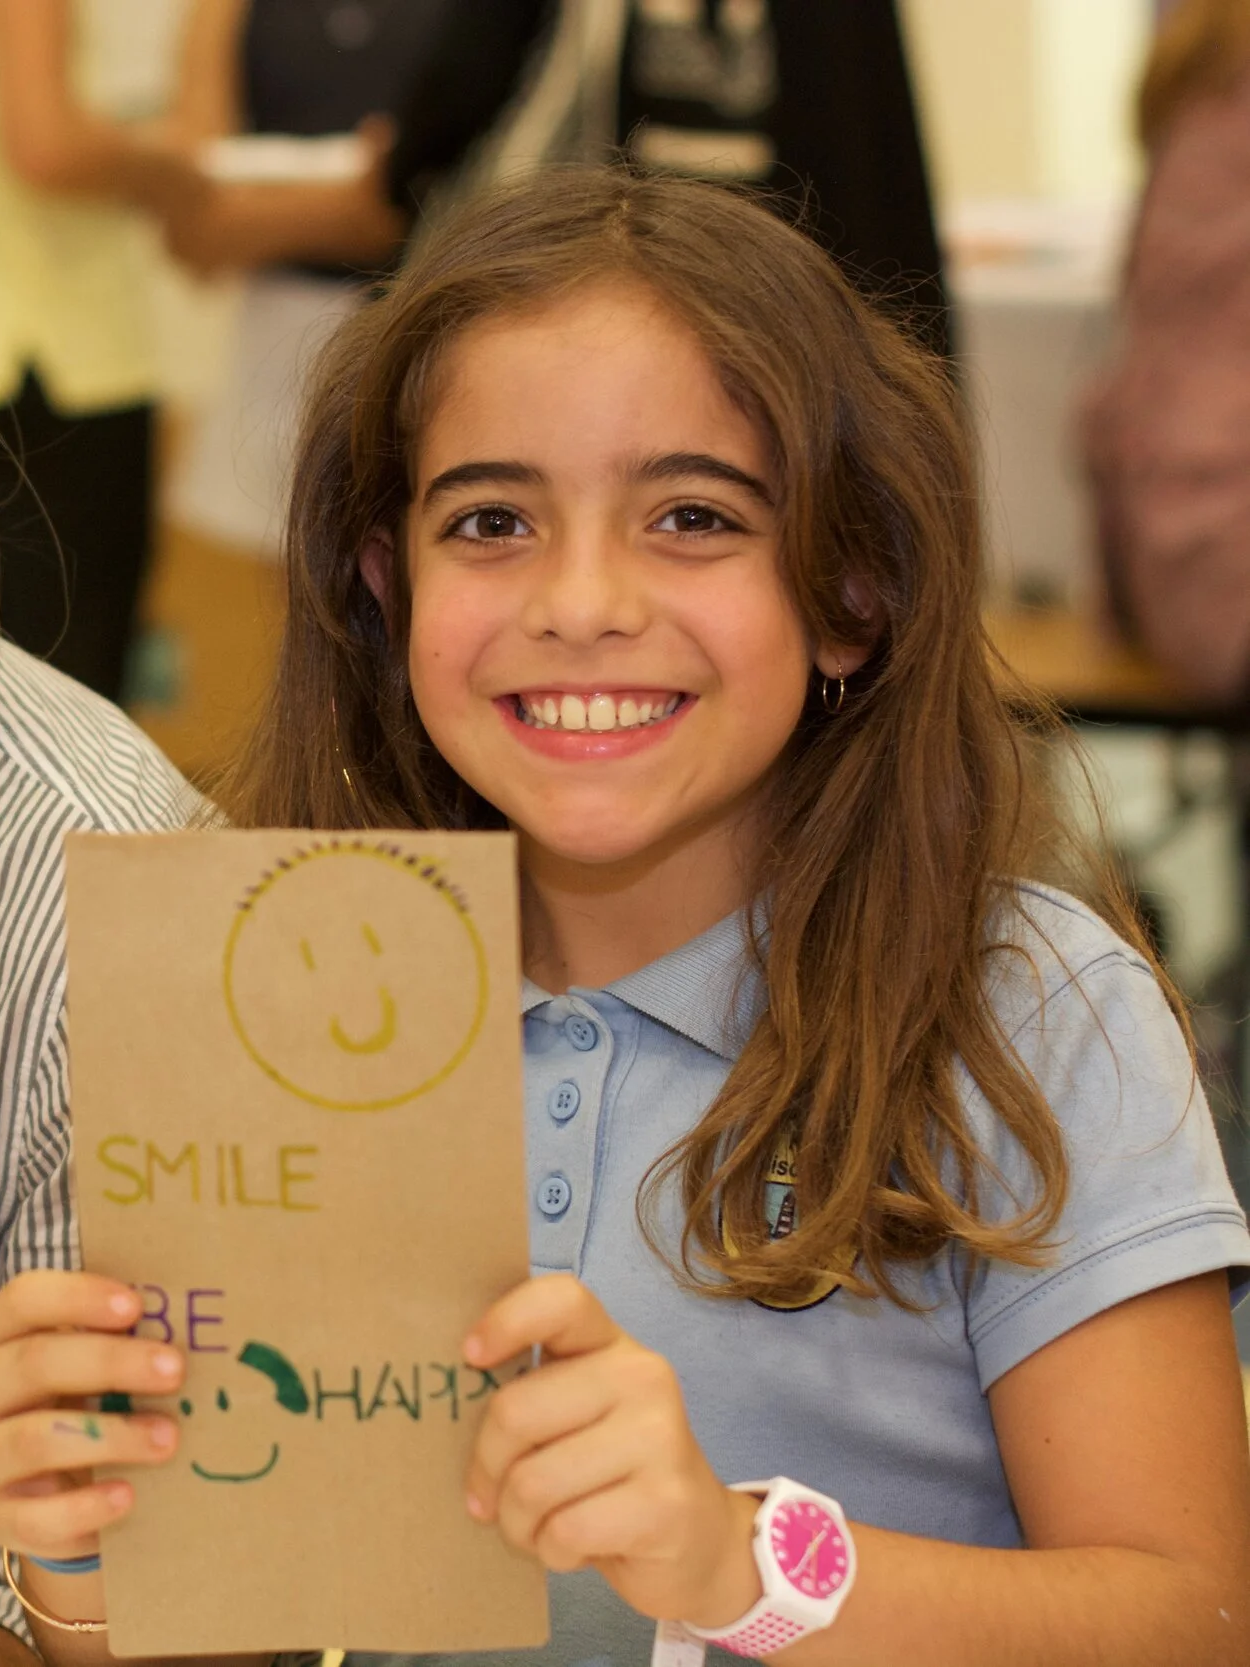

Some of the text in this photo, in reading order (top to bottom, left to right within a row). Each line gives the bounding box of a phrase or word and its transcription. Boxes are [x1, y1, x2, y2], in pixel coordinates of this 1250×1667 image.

[96, 1133, 322, 1212] SMILE
[127, 1283, 229, 1353] BE
[313, 1360, 527, 1422] HAPP
